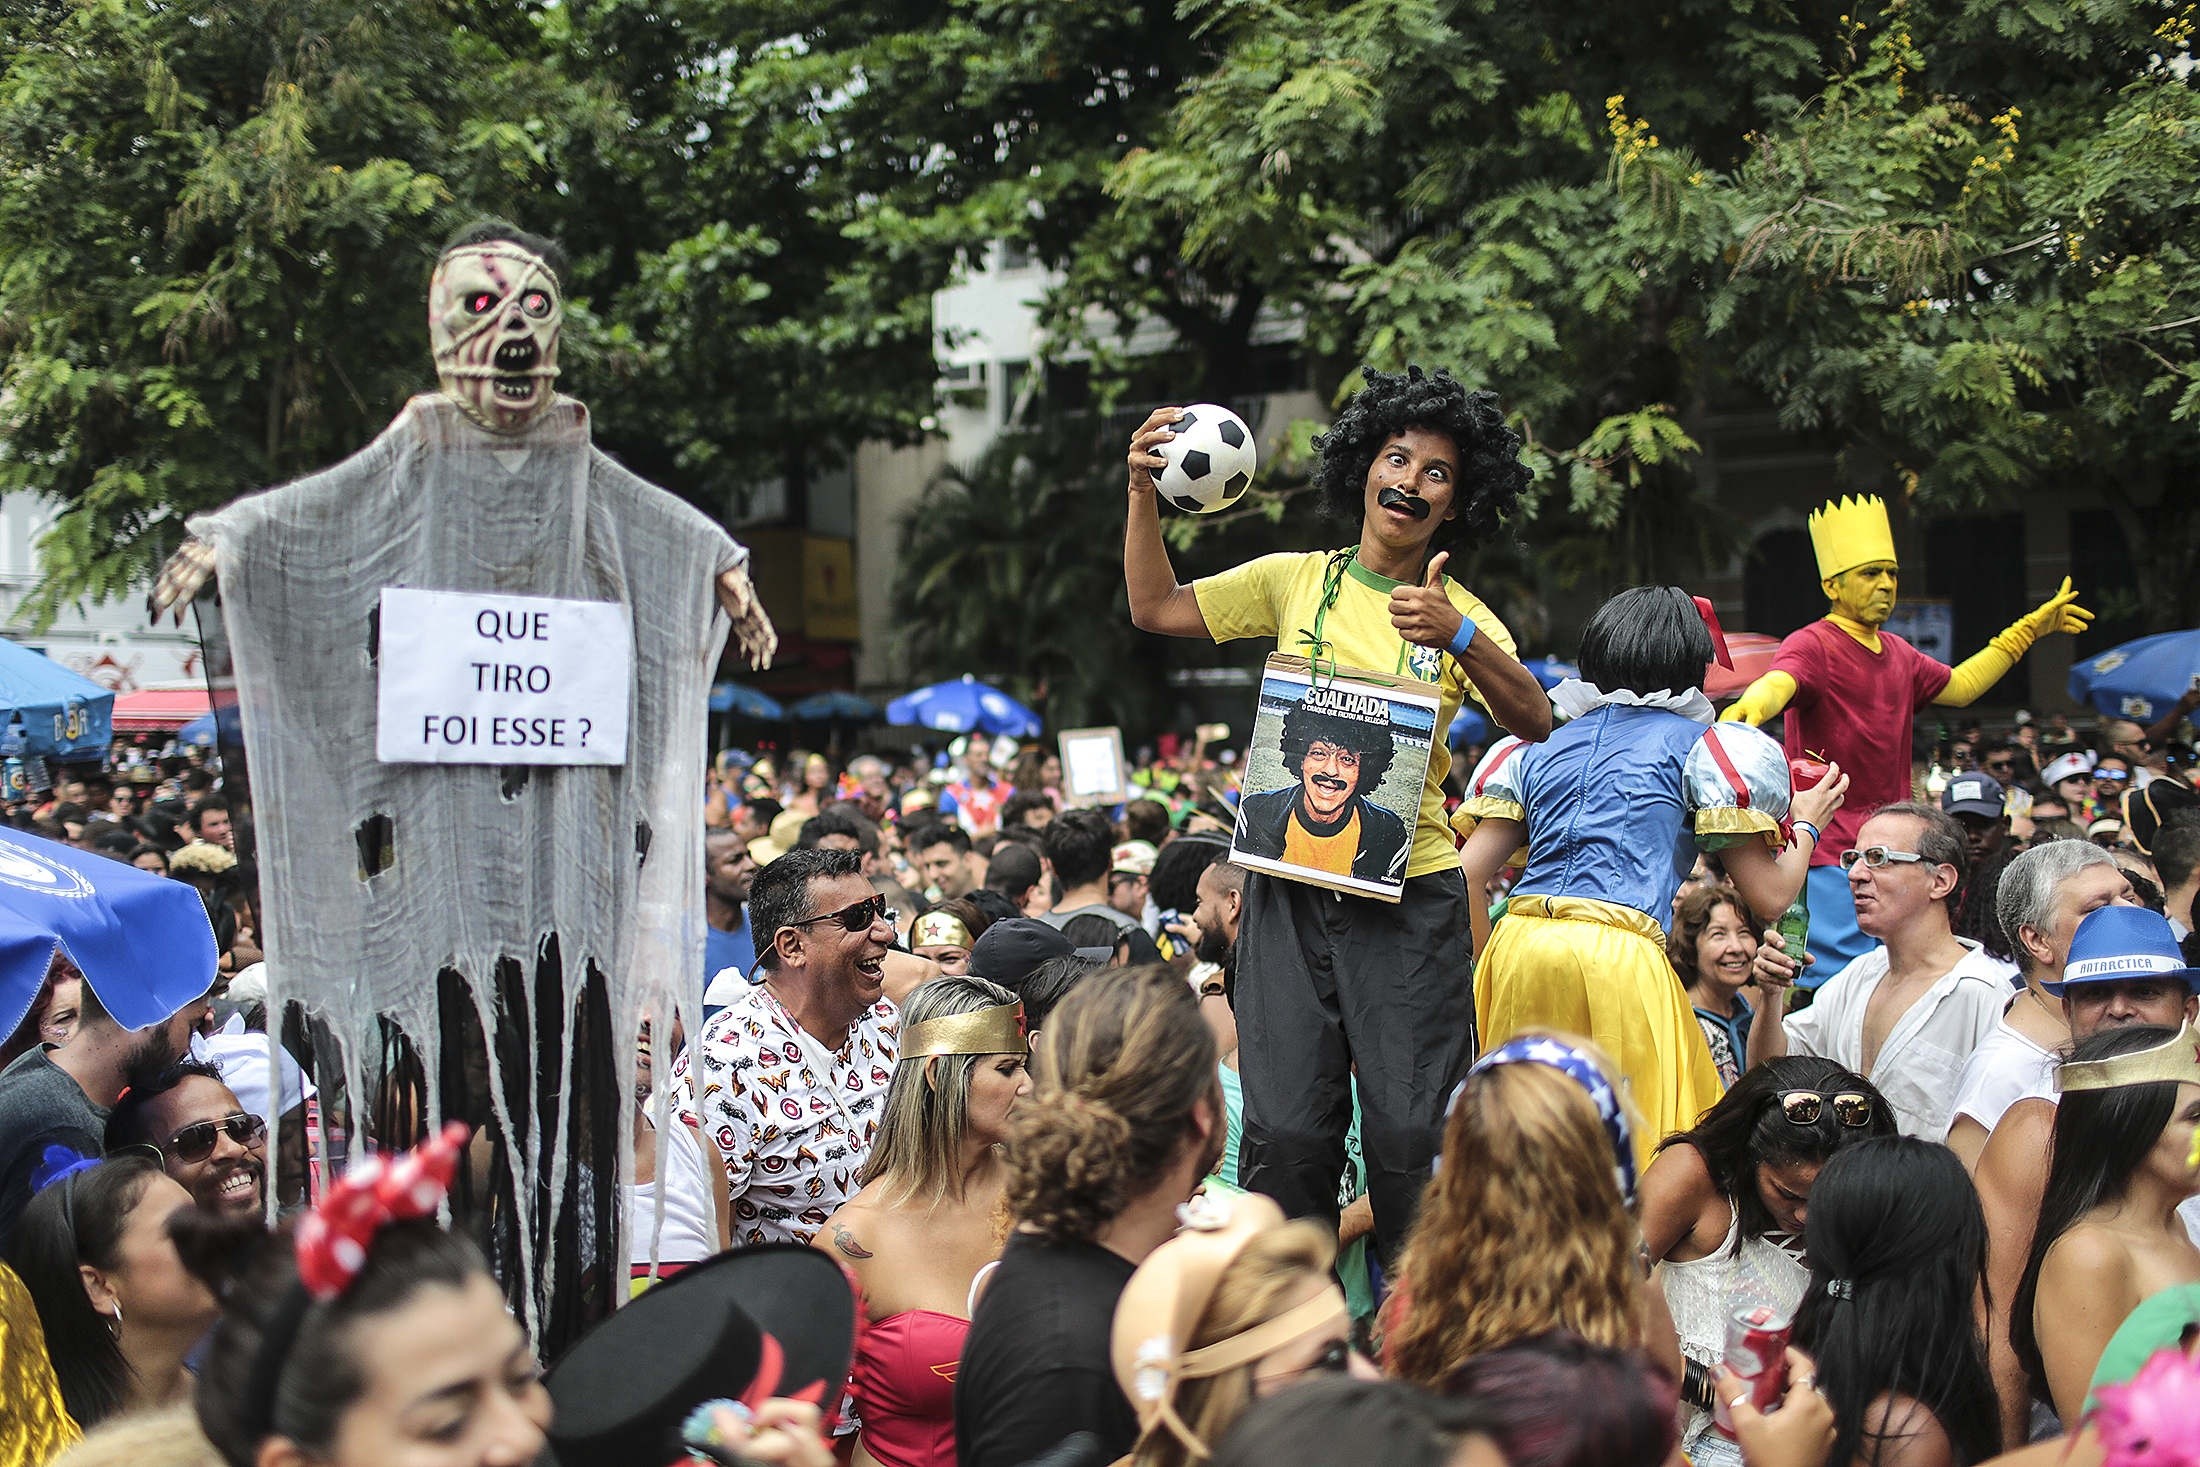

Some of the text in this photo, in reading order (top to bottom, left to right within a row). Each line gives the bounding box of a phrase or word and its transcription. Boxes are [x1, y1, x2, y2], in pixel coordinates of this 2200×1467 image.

[476, 609, 549, 643] QUE
[471, 662, 551, 694] TIRO
[1301, 703, 1307, 711] O
[1306, 704, 1327, 715] CRAQUE
[1326, 708, 1338, 717] QUE
[1338, 710, 1357, 720] FALTOU
[1355, 713, 1364, 722] NA
[423, 715, 592, 748] FOI ESSE ?
[2079, 958, 2153, 975] ANTARCTICA
